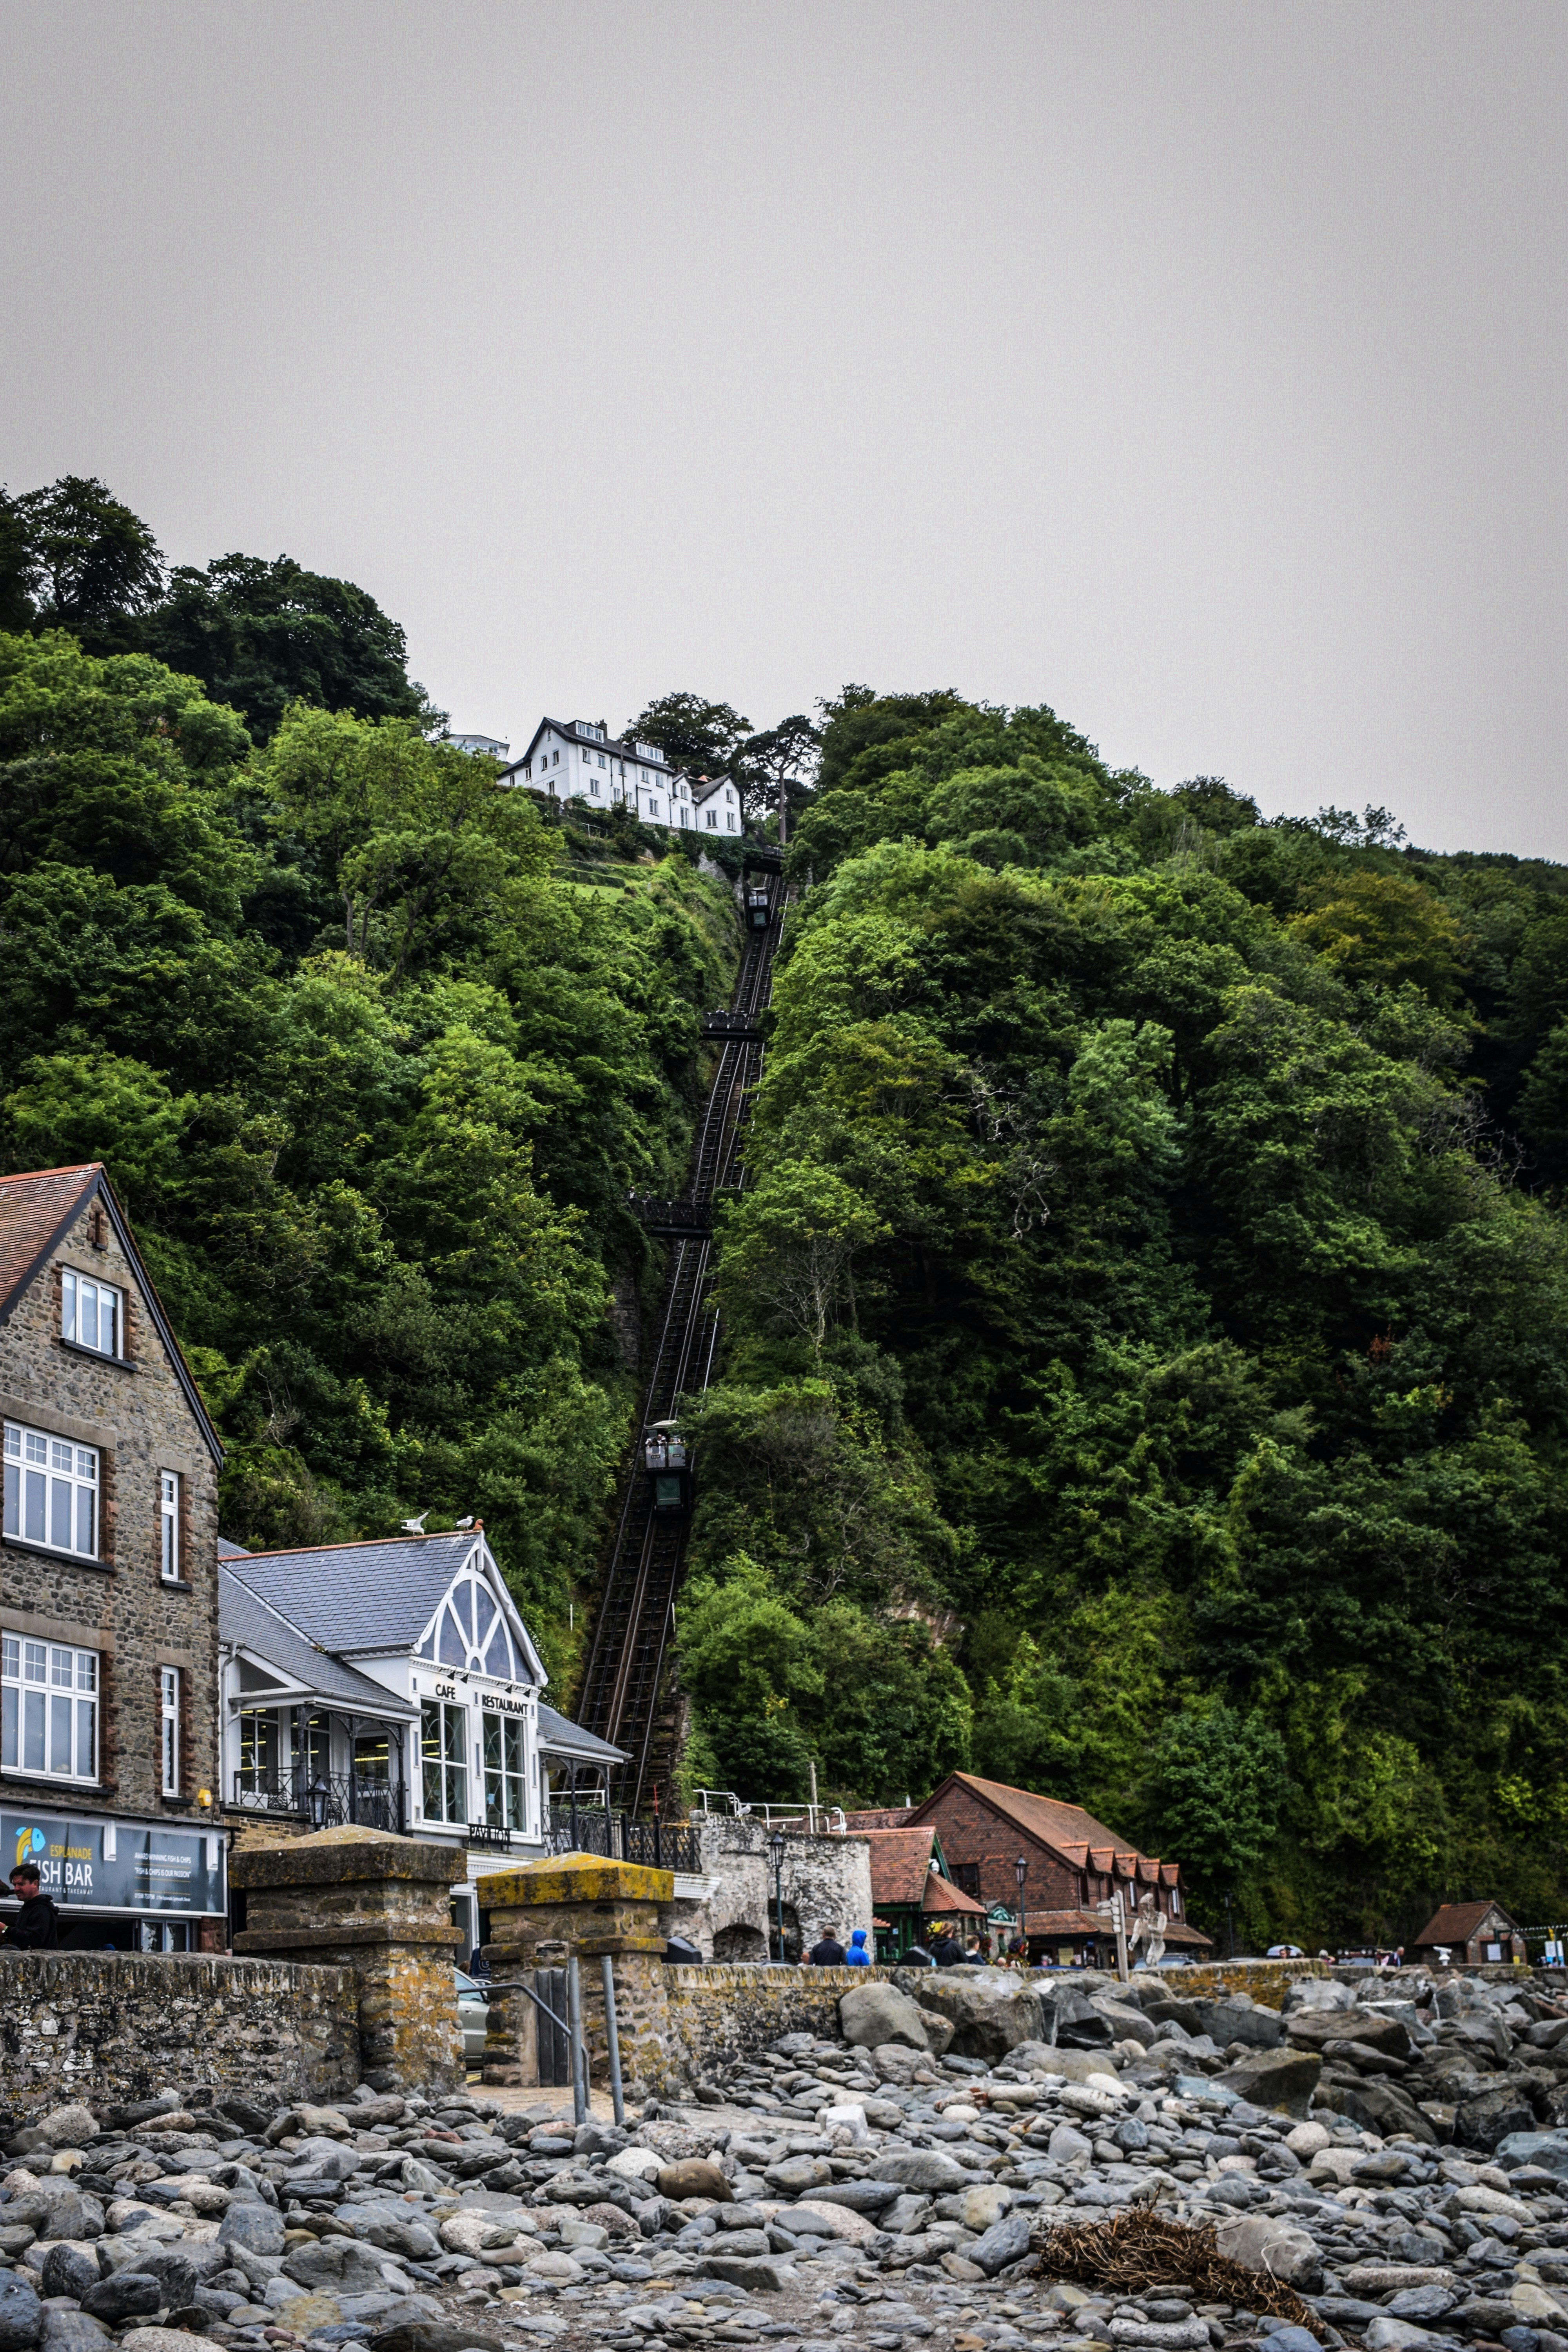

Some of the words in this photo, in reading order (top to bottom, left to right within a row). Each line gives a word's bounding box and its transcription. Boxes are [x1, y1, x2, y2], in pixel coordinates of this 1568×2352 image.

[436, 1684, 456, 1699] CAFE
[482, 1694, 528, 1715] RESTAURANT
[470, 1826, 510, 1841] PAVILION
[50, 1844, 92, 1860] ESPLANADE
[30, 1859, 61, 1884] ISH
[65, 1862, 93, 1886] BAR
